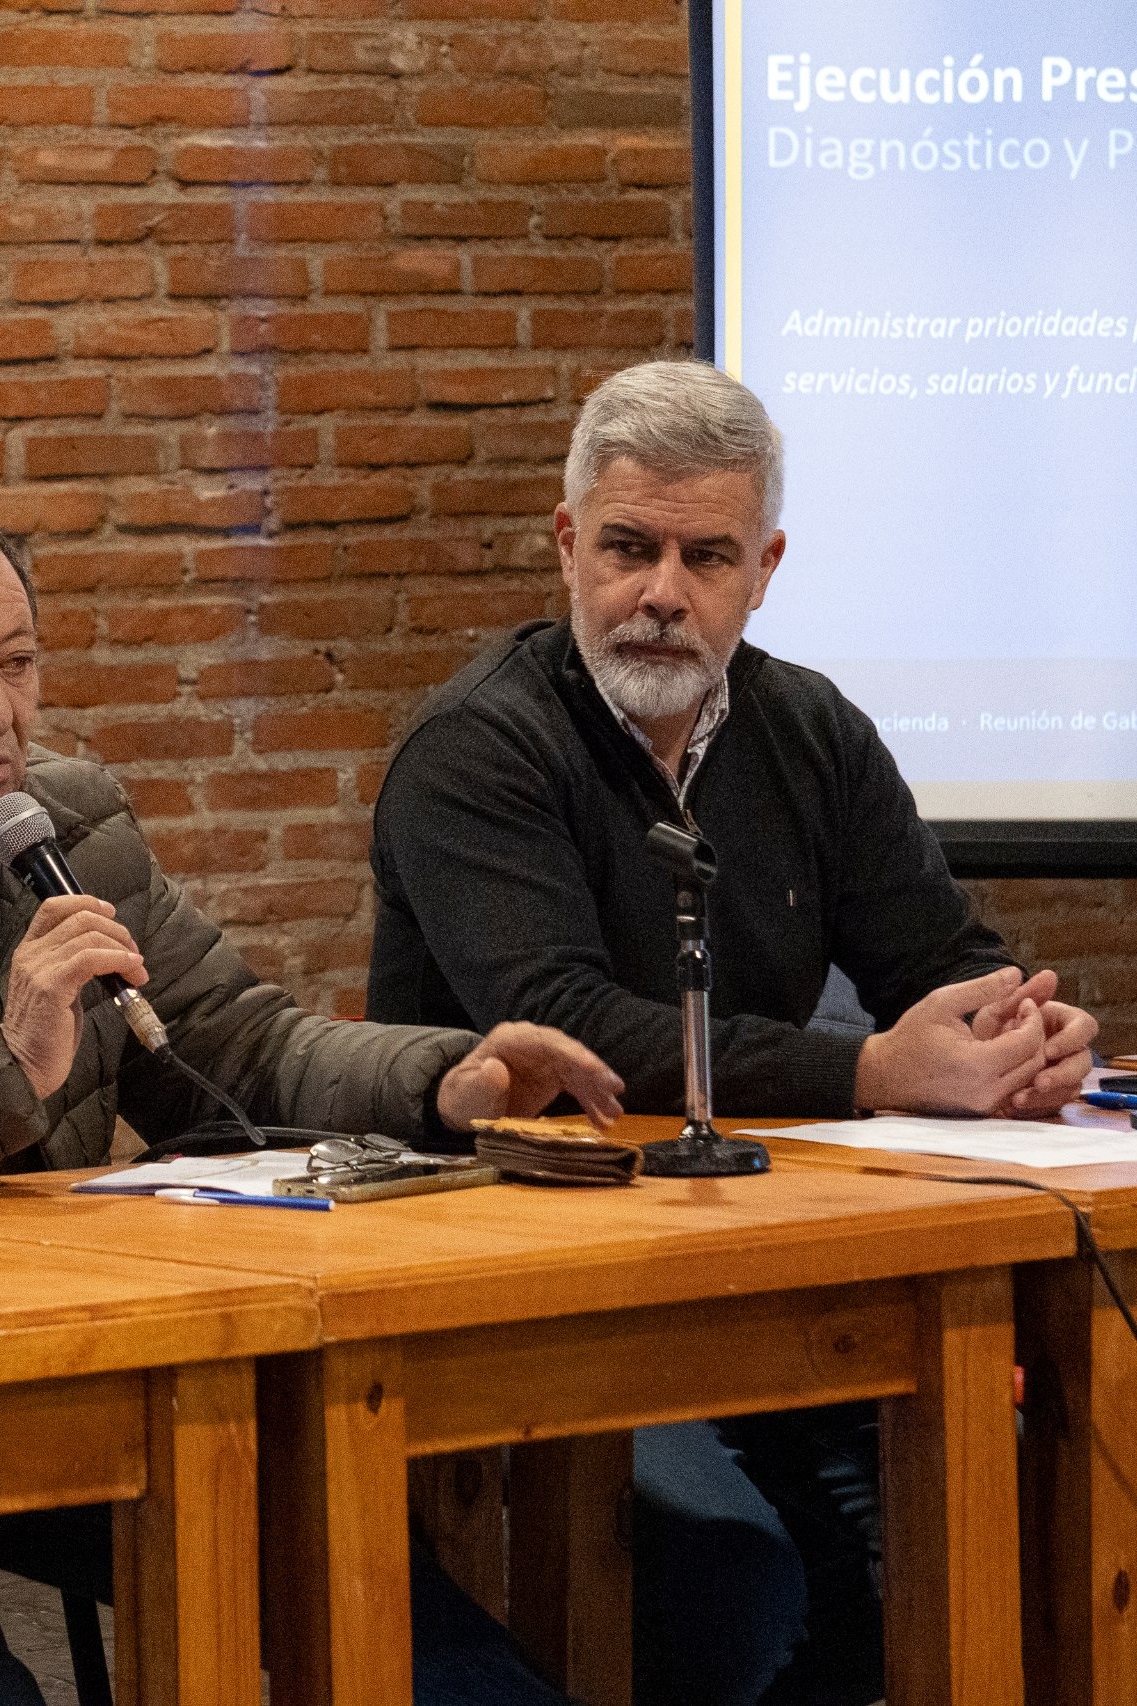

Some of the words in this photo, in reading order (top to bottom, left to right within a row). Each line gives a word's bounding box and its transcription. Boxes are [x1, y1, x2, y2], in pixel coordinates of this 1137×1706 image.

[767, 52, 1023, 112] Ejecución
[768, 126, 1051, 180] Diagnóstico
[1063, 137, 1089, 180] y
[1108, 129, 1134, 169] P
[781, 309, 961, 338] Administrar
[964, 309, 1129, 343] prioridades
[782, 367, 918, 399] servicios,
[925, 366, 1037, 395] salarios
[1043, 371, 1060, 399] y
[980, 710, 1063, 732] Reunión
[1070, 711, 1096, 730] de
